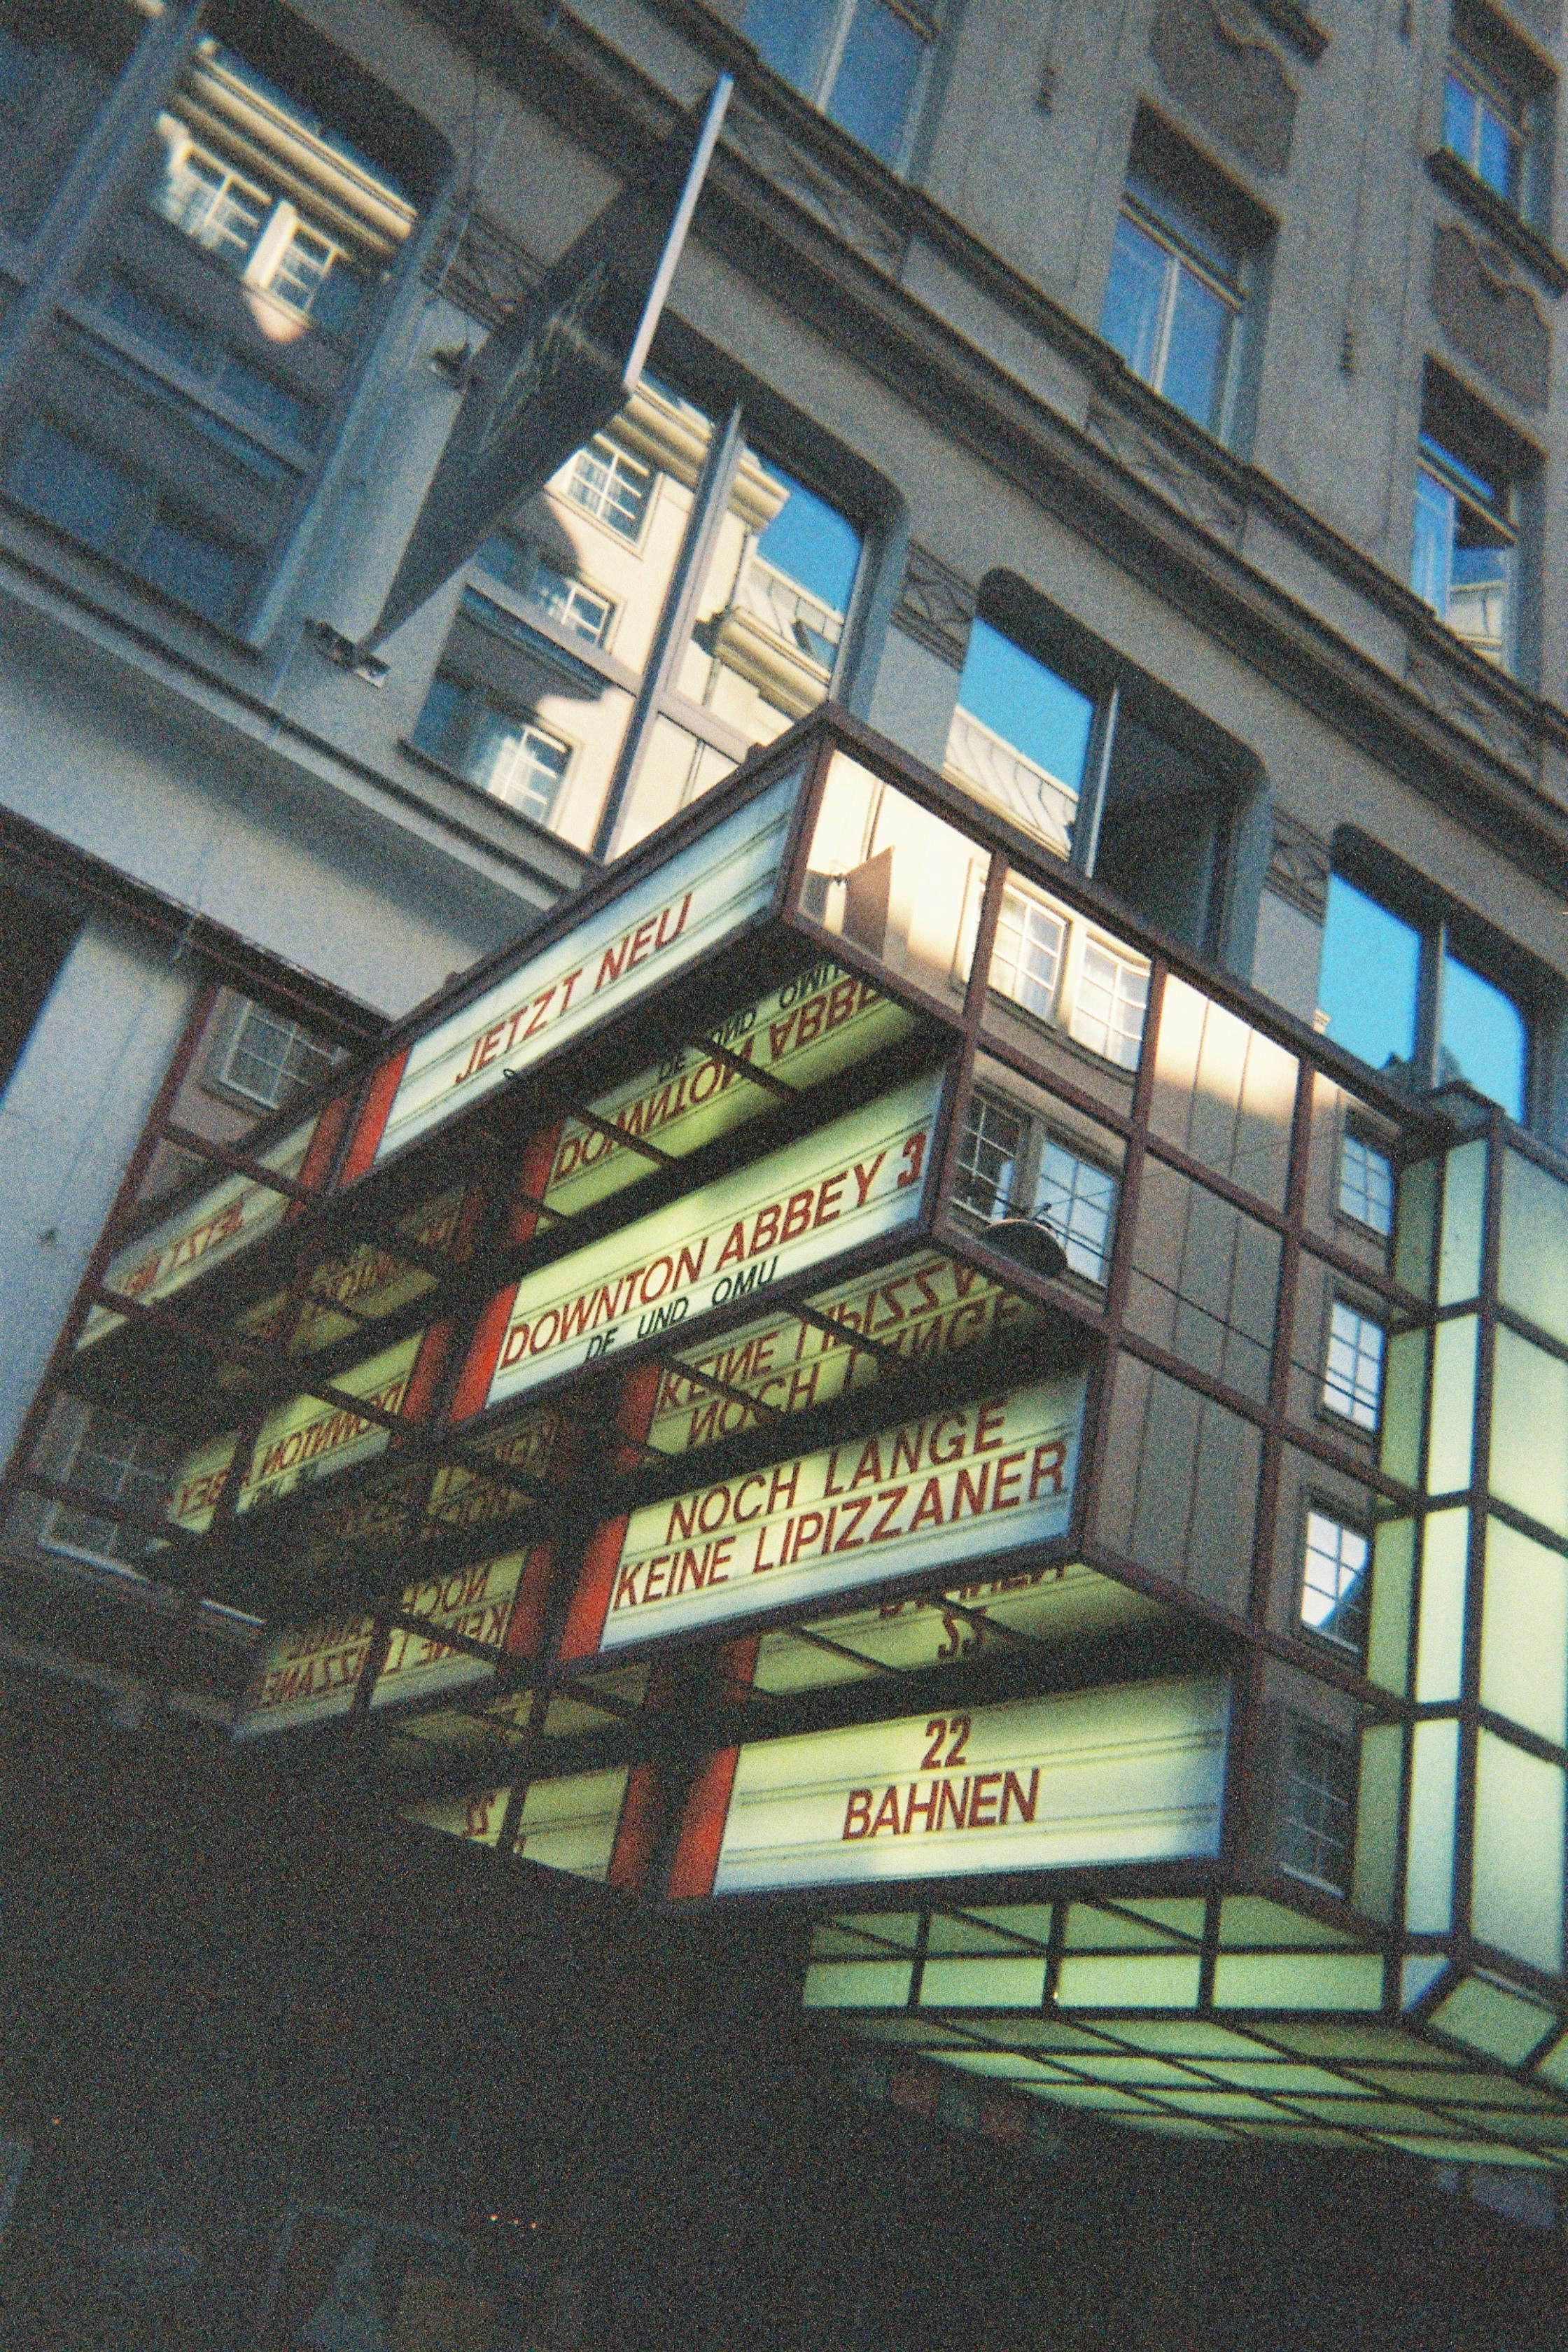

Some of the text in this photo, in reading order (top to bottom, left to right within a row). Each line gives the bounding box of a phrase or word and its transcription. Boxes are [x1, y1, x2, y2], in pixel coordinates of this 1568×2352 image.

[454, 892, 694, 1084] JETZT NEU
[498, 1238, 710, 1371] DOWNTON
[714, 1152, 888, 1273] ABBEY
[896, 1130, 930, 1190] 3
[583, 1256, 780, 1365] DE UND OMU
[612, 1441, 1069, 1611] KEINE LIPIZZANER
[664, 1397, 1011, 1548] NOCH LANGE
[841, 1767, 1040, 1841] BAHNEN
[920, 1715, 972, 1771] 22
